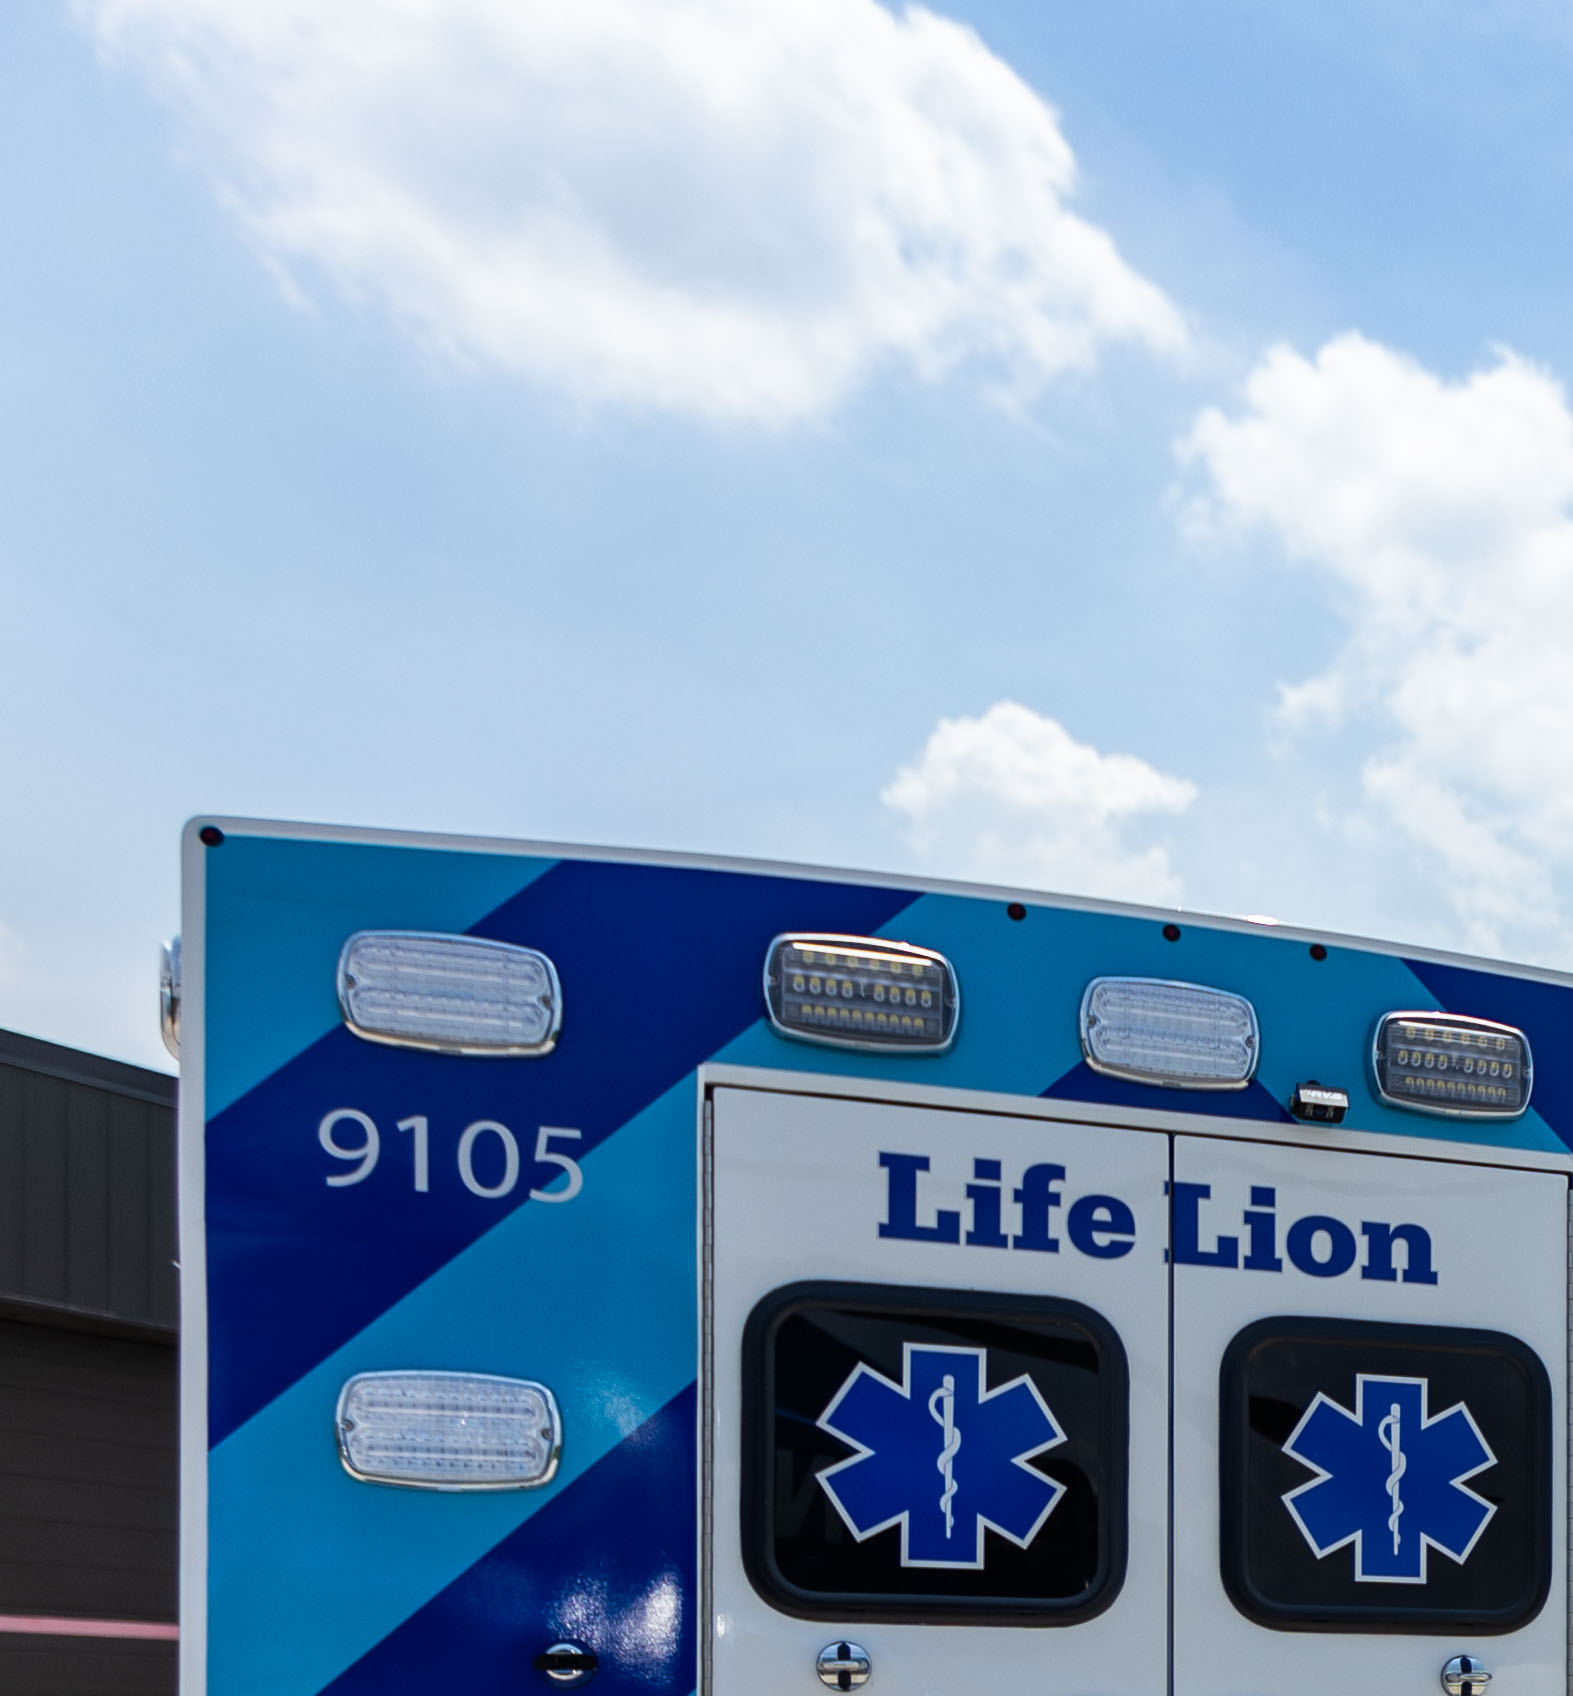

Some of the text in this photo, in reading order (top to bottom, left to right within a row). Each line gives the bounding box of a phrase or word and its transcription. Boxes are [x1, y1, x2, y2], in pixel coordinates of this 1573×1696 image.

[318, 1108, 583, 1203] 9105
[878, 1151, 1438, 1286] Life Lion
